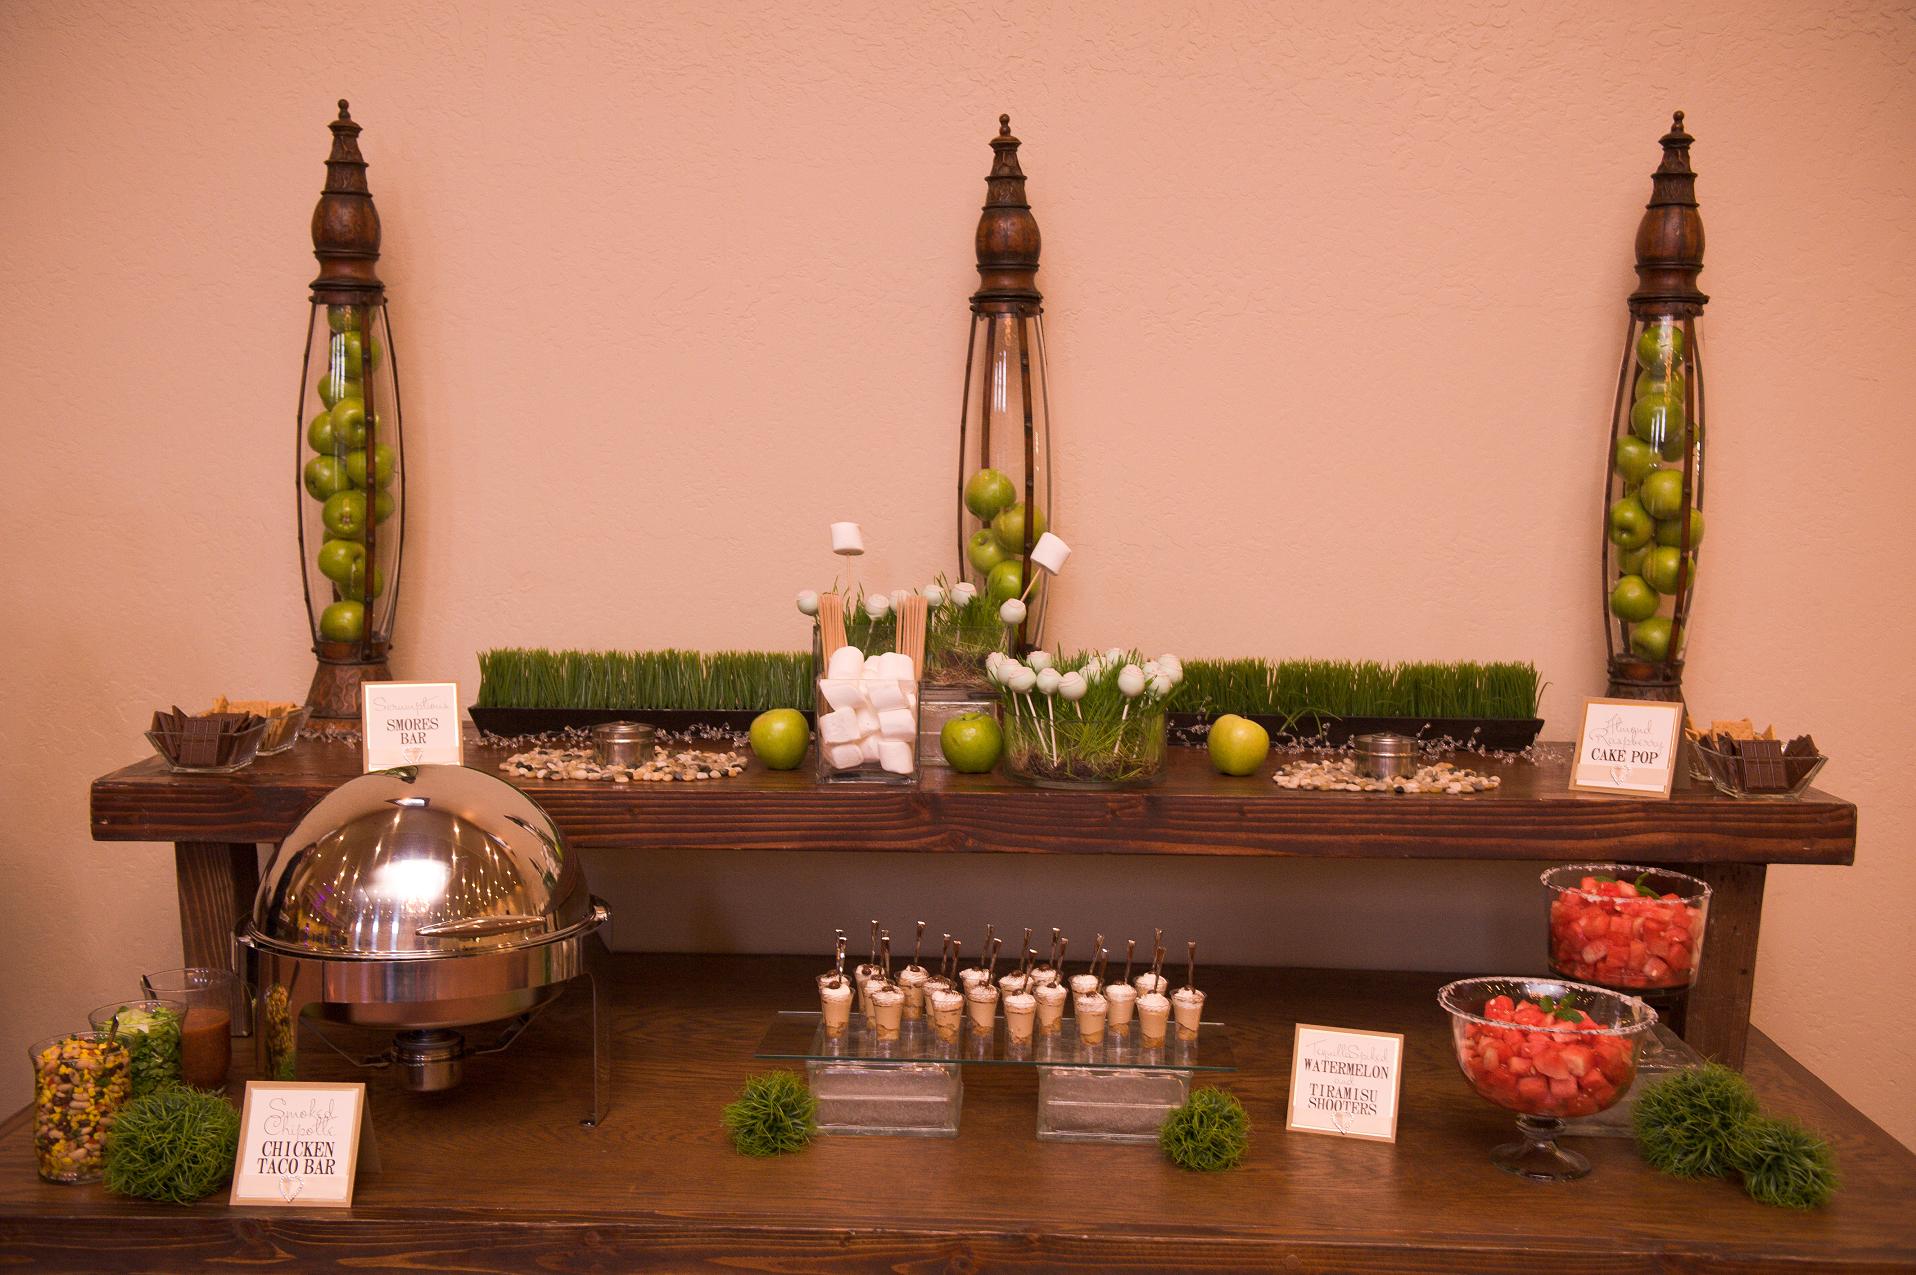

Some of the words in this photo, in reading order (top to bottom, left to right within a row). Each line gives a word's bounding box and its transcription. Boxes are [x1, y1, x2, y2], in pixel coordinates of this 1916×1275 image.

[386, 717, 439, 732] SMORES
[1604, 713, 1654, 737] Almond
[400, 732, 427, 745] BAR
[1588, 727, 1665, 755] Raspberry
[1591, 747, 1626, 762] CAKE
[1631, 751, 1659, 764] POP
[1304, 1058, 1390, 1080] WATERMELON
[1309, 1082, 1378, 1103] TIRAMISU
[268, 1097, 339, 1119] Smoked
[1308, 1097, 1377, 1116] SHOOTERS
[262, 1140, 335, 1158] CHICKEN
[257, 1157, 299, 1175] TACO
[304, 1158, 336, 1175] BAR
